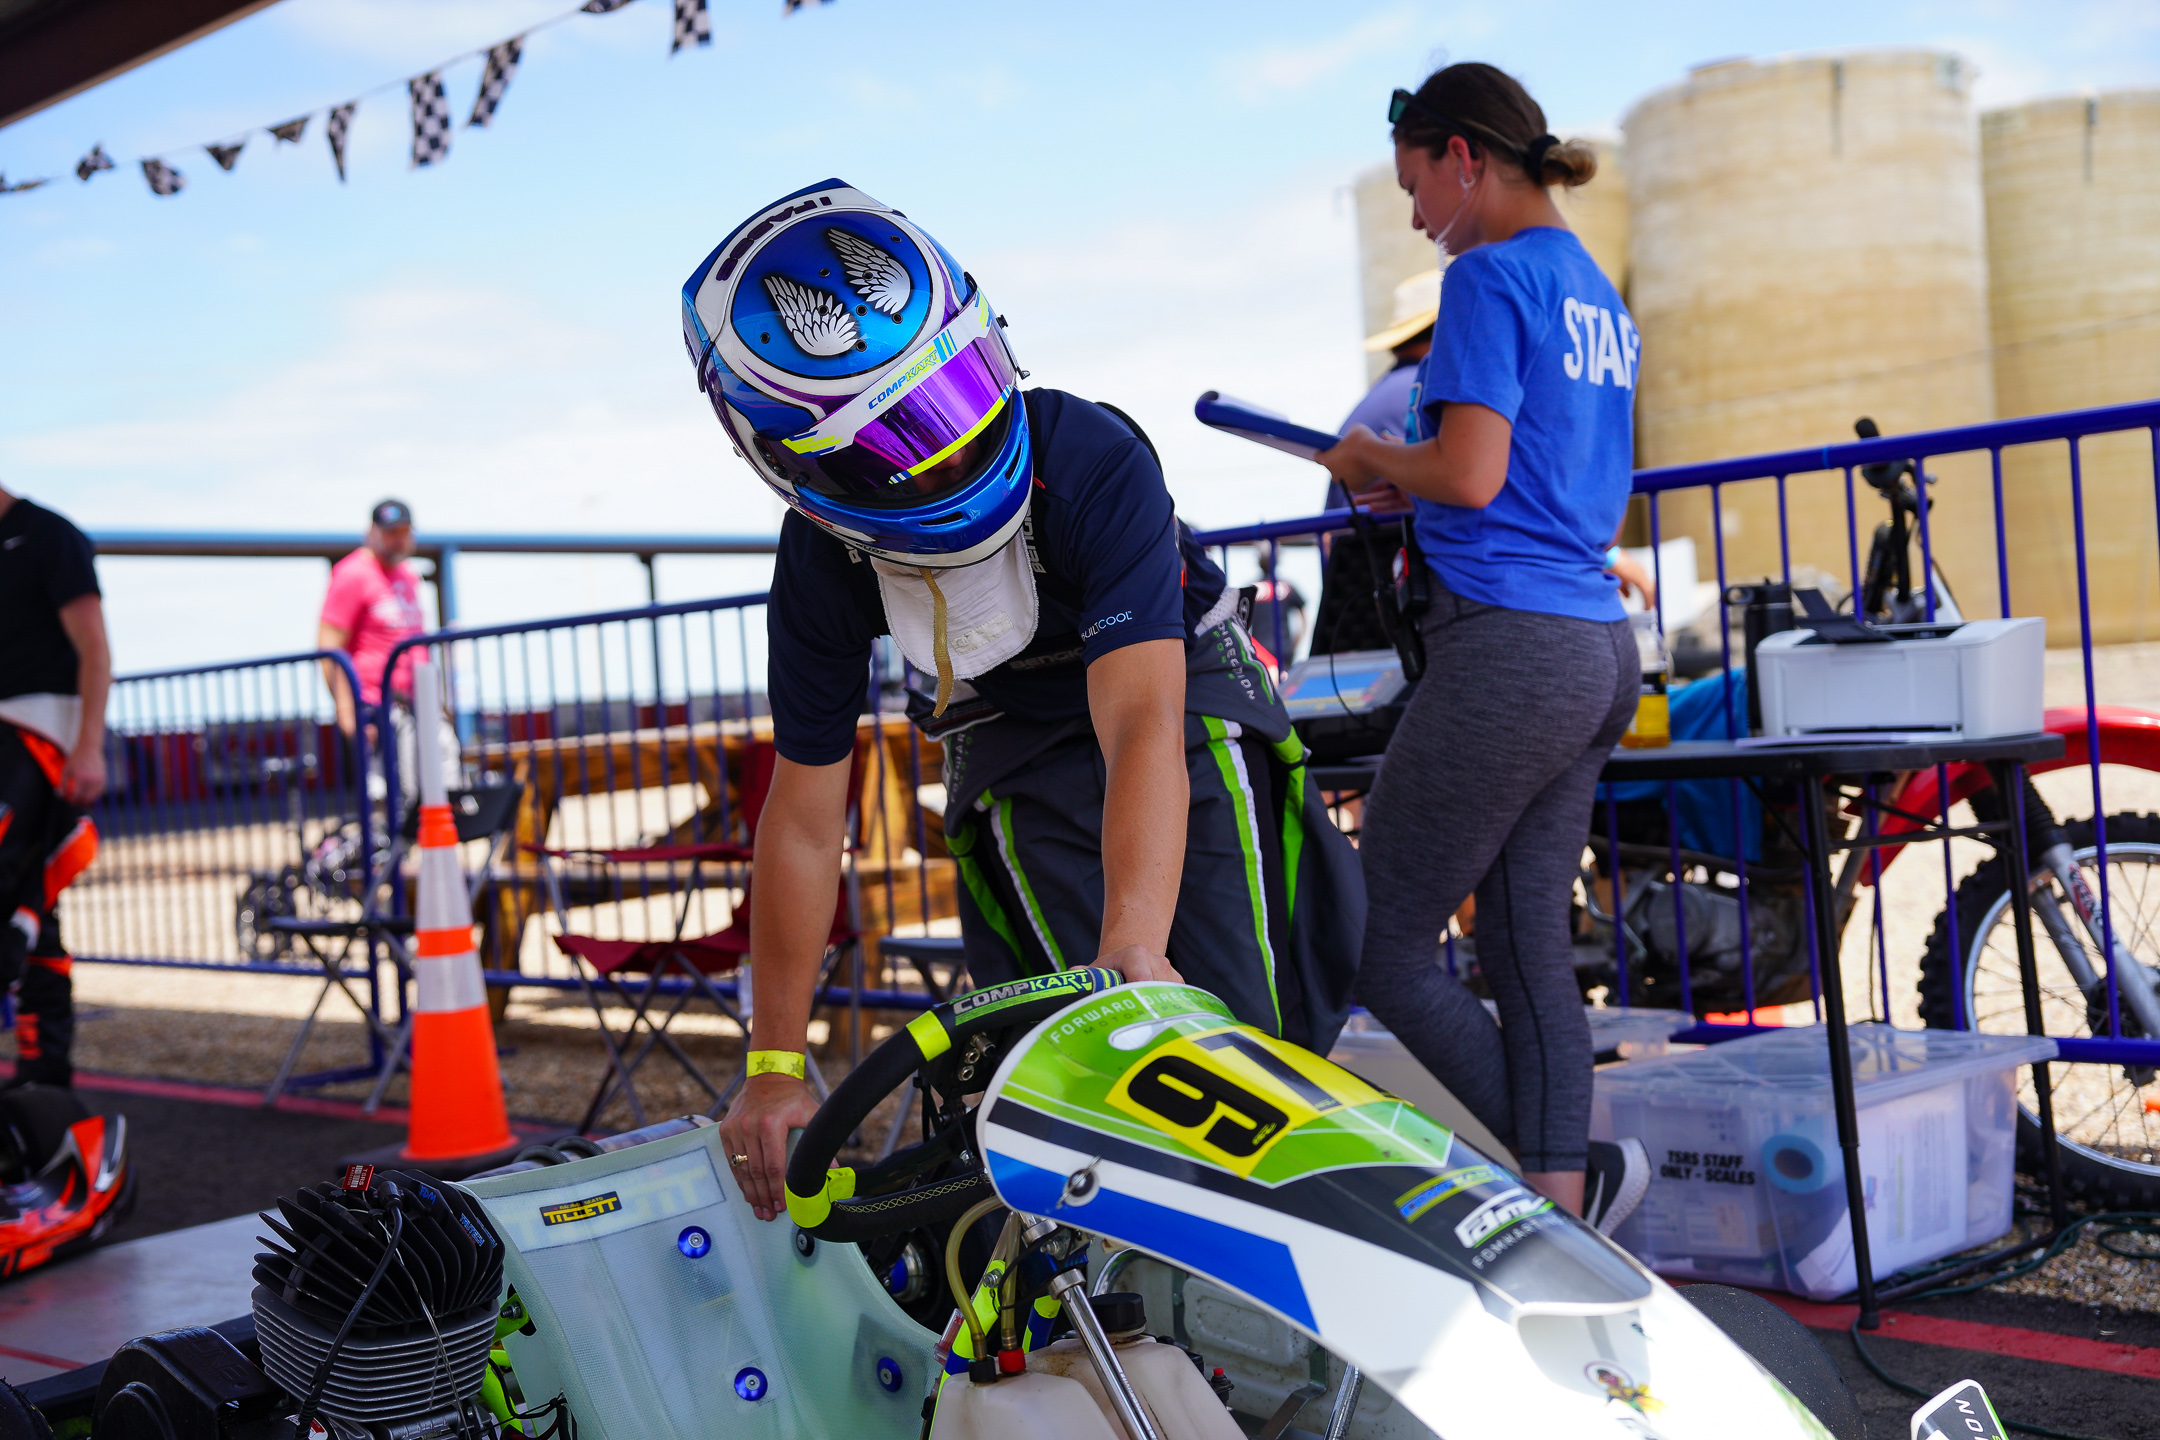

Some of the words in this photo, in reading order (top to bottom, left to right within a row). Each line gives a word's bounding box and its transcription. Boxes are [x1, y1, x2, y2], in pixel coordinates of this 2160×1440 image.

[1563, 296, 1639, 391] STAF
[867, 349, 940, 411] COMPKART
[953, 969, 1090, 1014] COMPKART
[1049, 997, 1137, 1045] FORWARD
[1660, 1164, 1692, 1180] ONLY
[1704, 1168, 1756, 1186] SCALES
[1667, 1149, 1700, 1166] TSRS
[1702, 1152, 1744, 1168] STAFF
[543, 1196, 618, 1224] TILLETT
